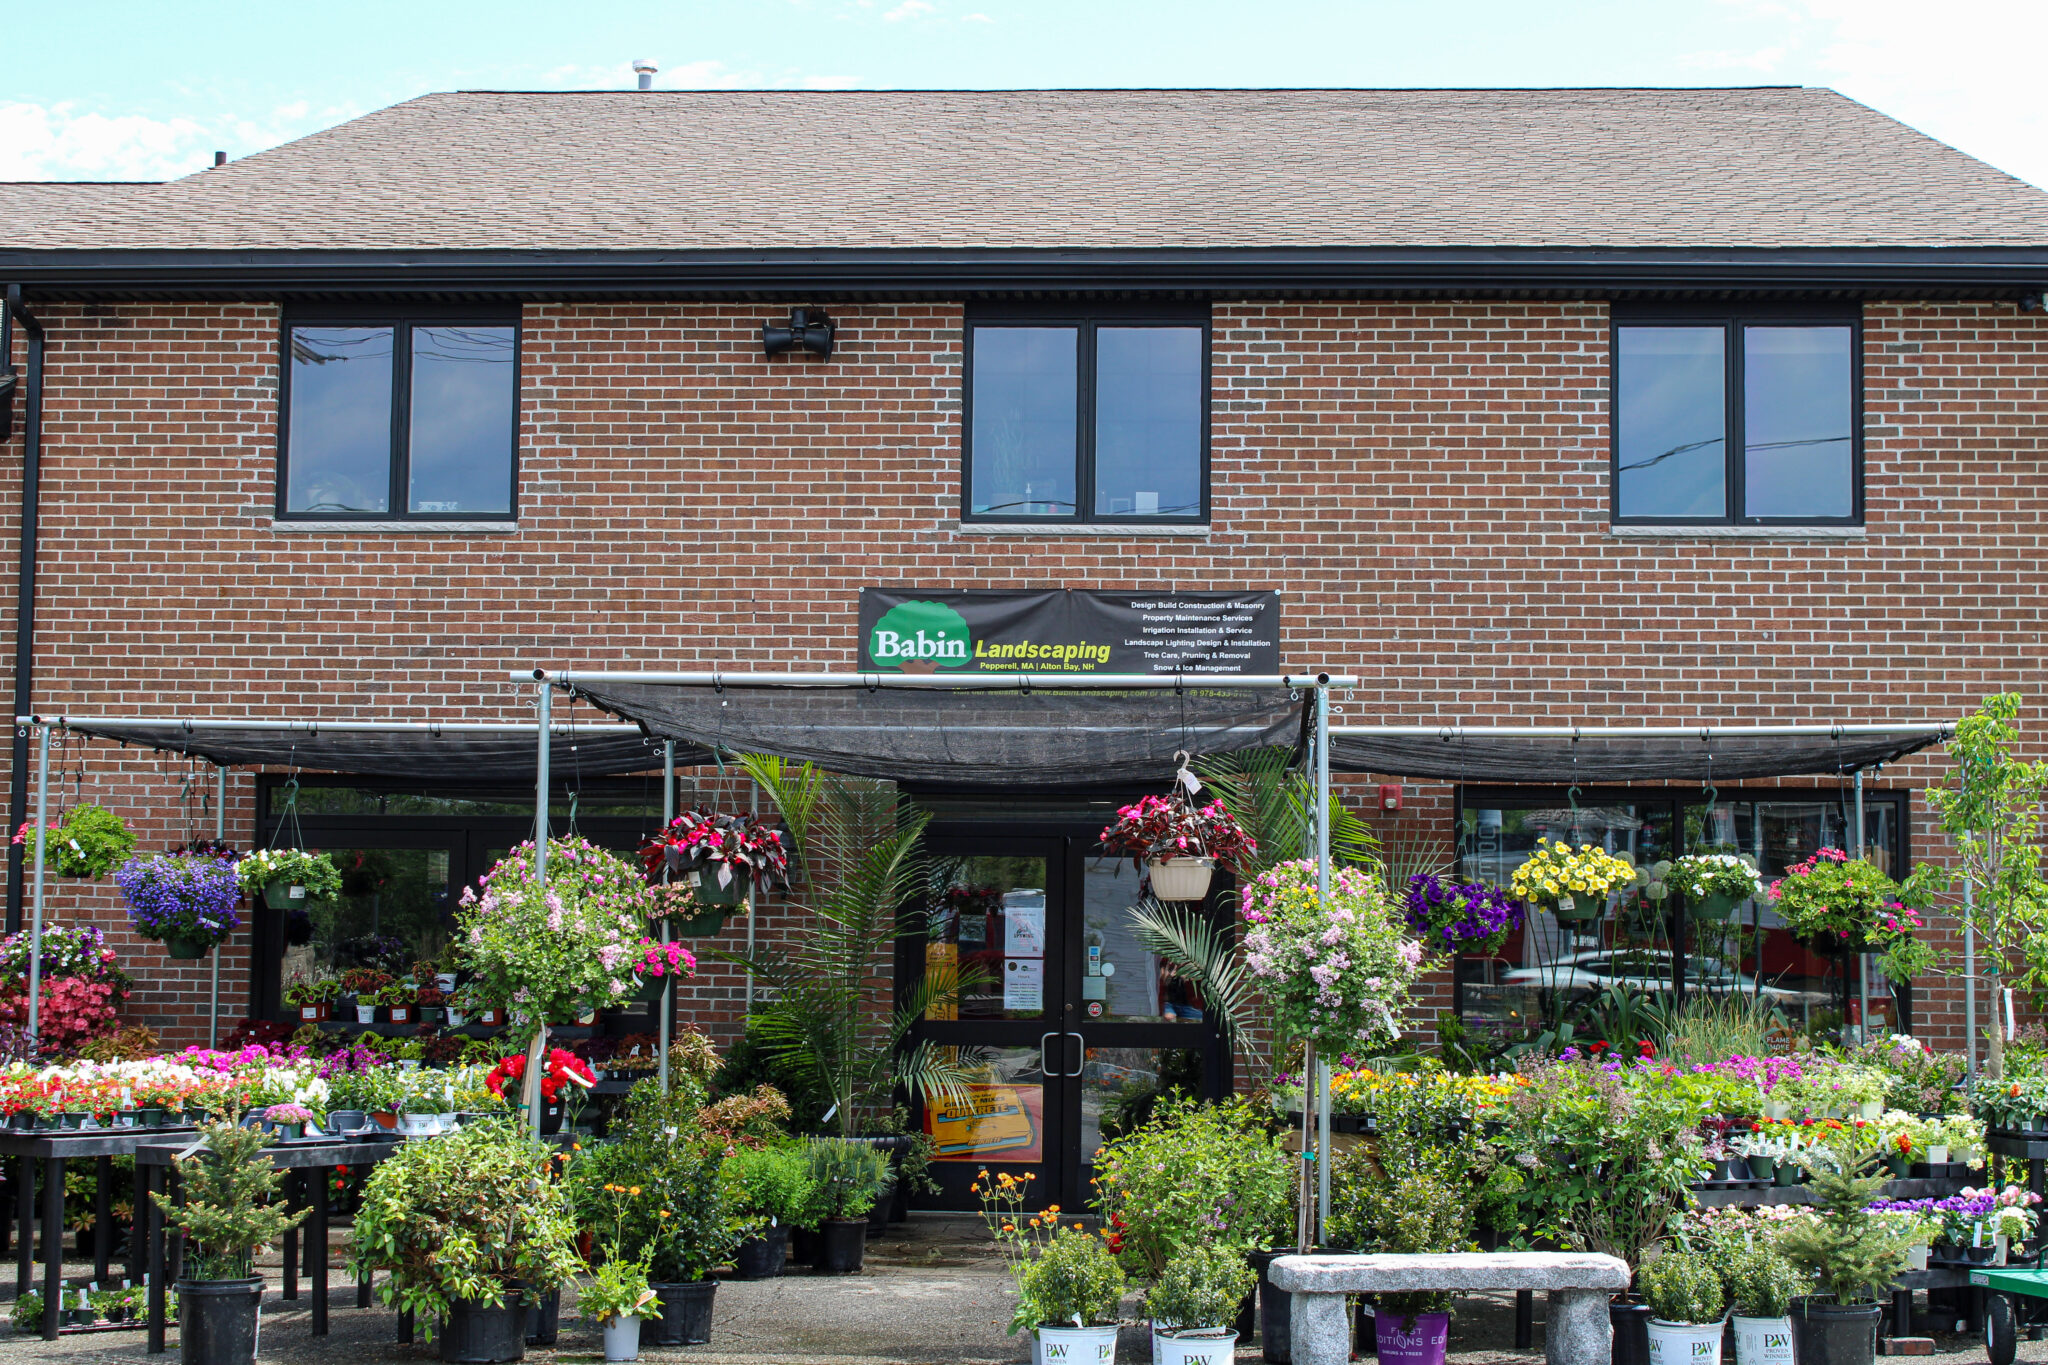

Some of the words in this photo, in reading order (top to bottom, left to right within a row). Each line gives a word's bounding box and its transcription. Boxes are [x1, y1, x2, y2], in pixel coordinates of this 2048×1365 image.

[1131, 602, 1156, 610] Design
[1234, 602, 1265, 610] Masonry
[1142, 614, 1174, 622] Property
[1142, 627, 1175, 635] Irrigation
[874, 629, 967, 658] Babin
[1124, 639, 1164, 647] Landscape
[1165, 640, 1195, 648] Lighting
[1196, 640, 1222, 648] Design
[974, 640, 1111, 664] Landscaping
[1143, 651, 1160, 659] Tree
[1160, 651, 1180, 660] Care,
[1181, 652, 1210, 660] Pruning
[1211, 651, 1218, 659] &
[1219, 651, 1251, 659] Removal
[980, 662, 1019, 671] Pepperell,
[1021, 662, 1035, 670] MA
[1040, 662, 1061, 670] Alton
[1063, 662, 1081, 672] Bay,
[1082, 662, 1095, 671] NH
[1194, 664, 1242, 672] Management
[1763, 1333, 1791, 1348] PW
[1045, 1343, 1070, 1358] PW
[1691, 1340, 1715, 1356] PW
